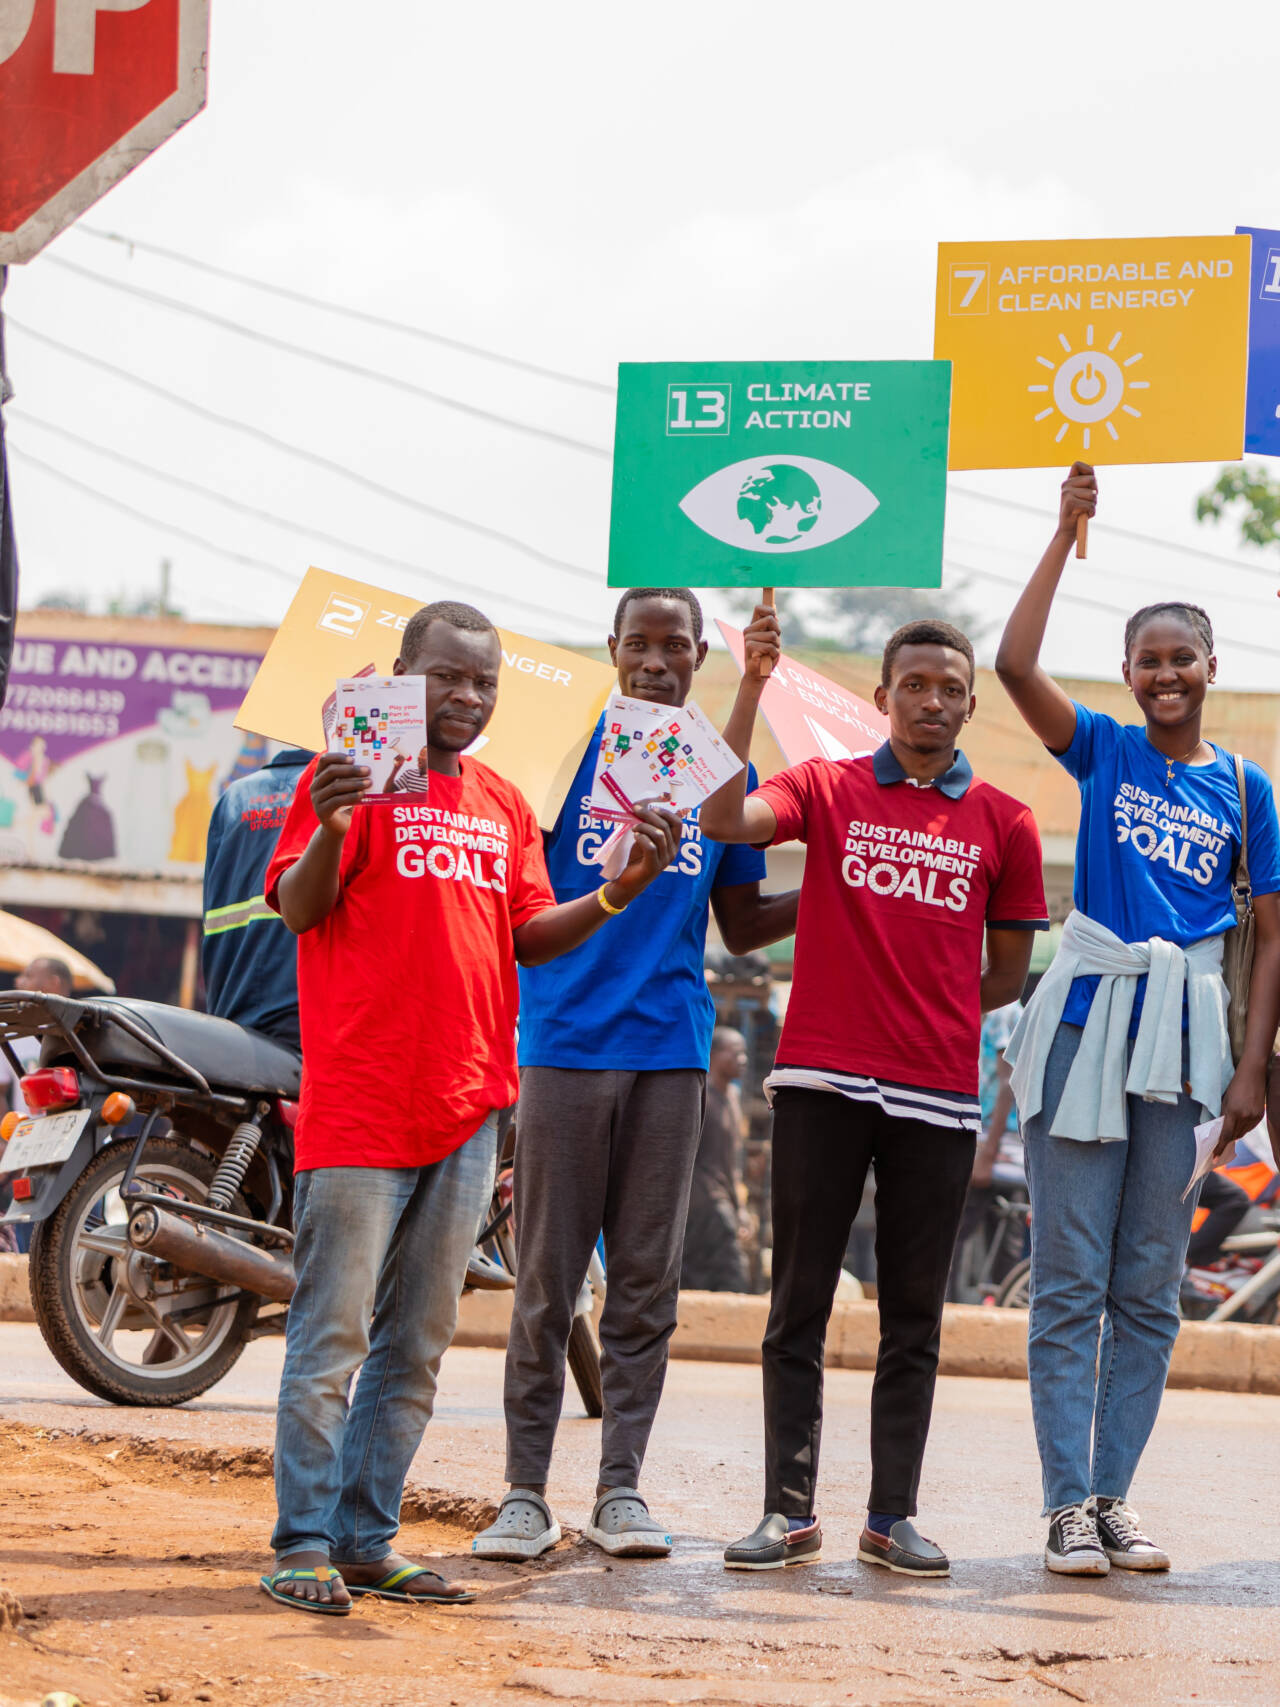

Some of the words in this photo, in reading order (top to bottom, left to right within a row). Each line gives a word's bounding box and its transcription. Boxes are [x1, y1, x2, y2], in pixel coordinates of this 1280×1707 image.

[954, 269, 985, 308] 7
[998, 261, 1171, 285] AFFORDABLE
[1178, 259, 1233, 279] AND
[998, 292, 1081, 313] CLEAN
[1090, 288, 1194, 310] ENERGY
[670, 390, 726, 428] 13
[746, 383, 871, 402] CLIMATE
[744, 410, 851, 429] ACTION
[320, 599, 364, 635] 2
[59, 645, 138, 680] AND
[375, 610, 407, 632] ZE
[501, 650, 573, 688] NGER
[786, 667, 860, 716] QUALITY
[393, 806, 508, 840] SUSTAINABLE
[1114, 794, 1226, 855] DEVELOPMENT
[1120, 782, 1231, 840] SUSTAINABLE
[395, 824, 509, 858] DEVELOPMENT
[844, 837, 978, 879] DEVELOPMENT
[847, 820, 982, 862] SUSTAINABLE
[1114, 810, 1219, 886] GOALS
[396, 844, 508, 894] GOALS
[841, 854, 971, 912] GOALS
